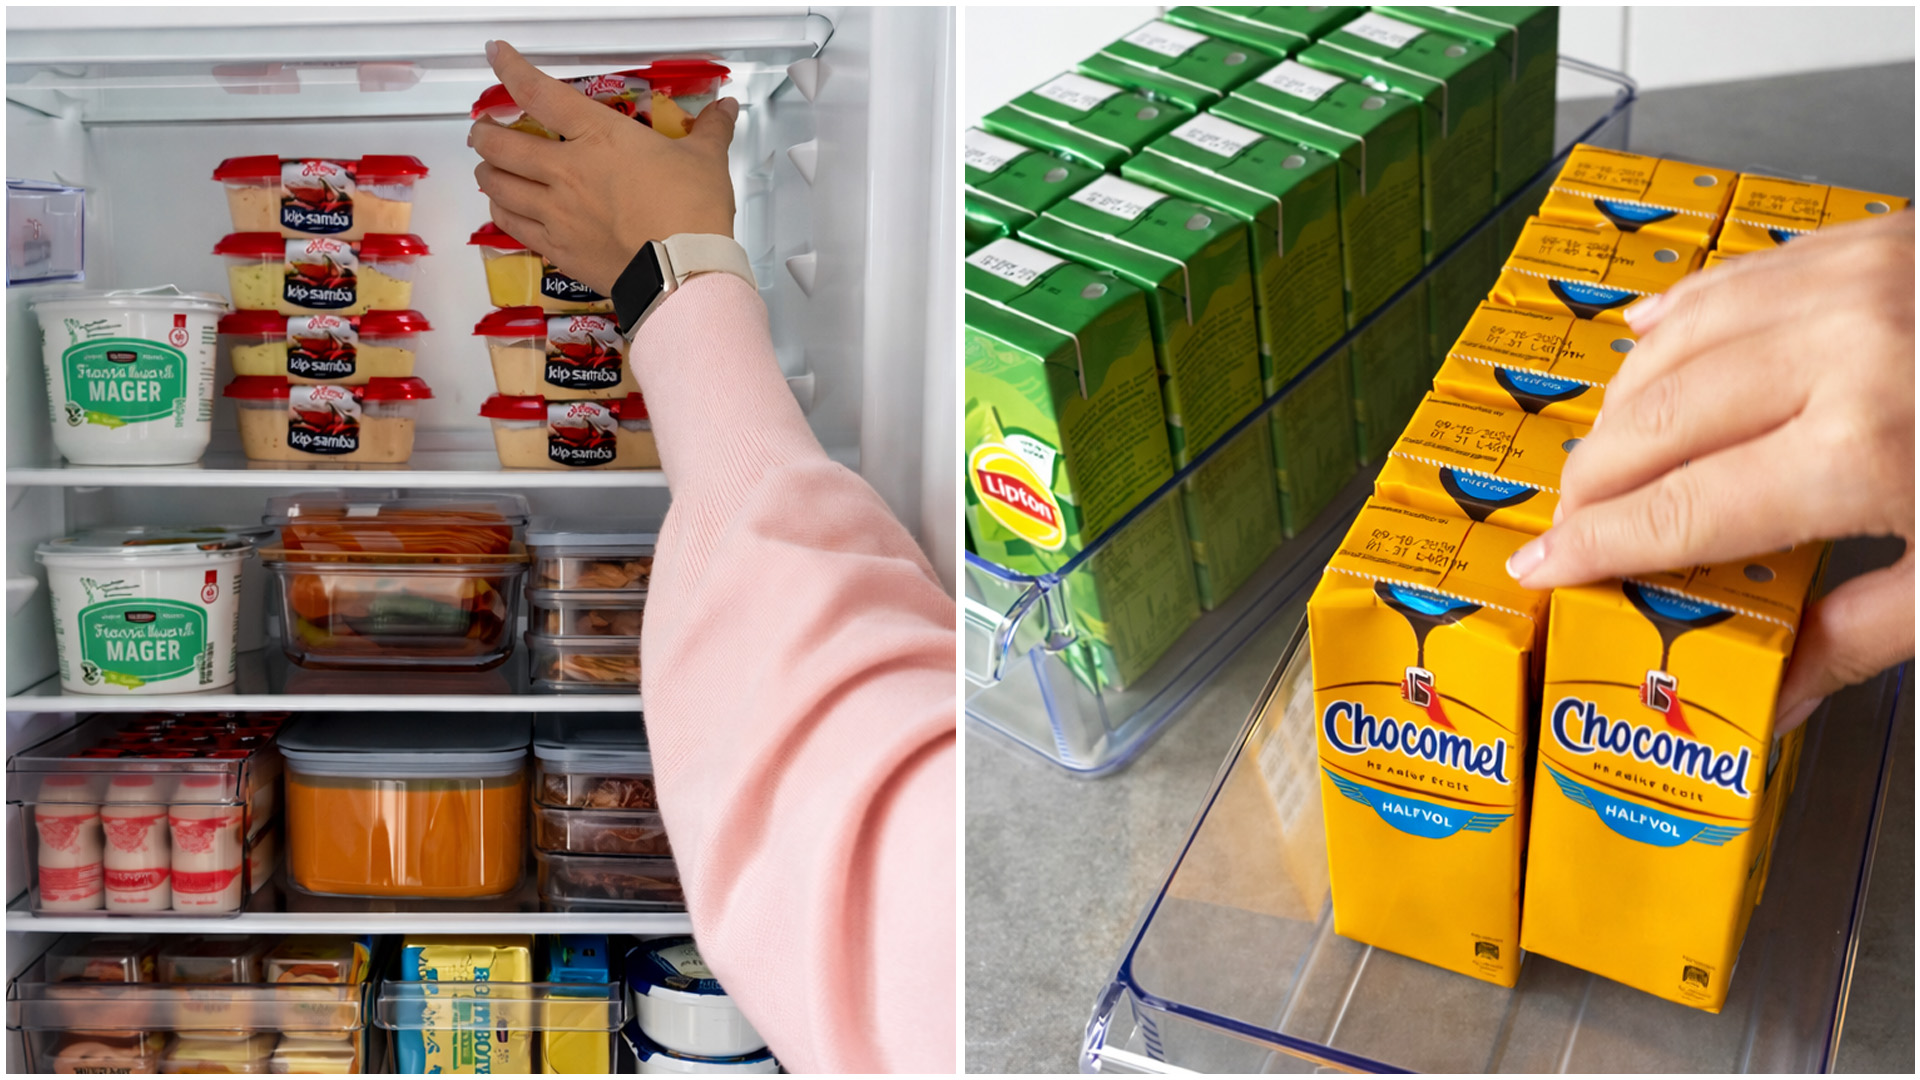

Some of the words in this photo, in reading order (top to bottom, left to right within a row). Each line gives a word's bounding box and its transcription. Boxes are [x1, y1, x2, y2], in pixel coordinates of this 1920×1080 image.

[88, 380, 162, 402] MAGER
[985, 474, 1053, 522] Lipton
[106, 639, 180, 662] MAGER
[1323, 700, 1511, 785] Chocomel
[1551, 696, 1752, 799] Chocomel
